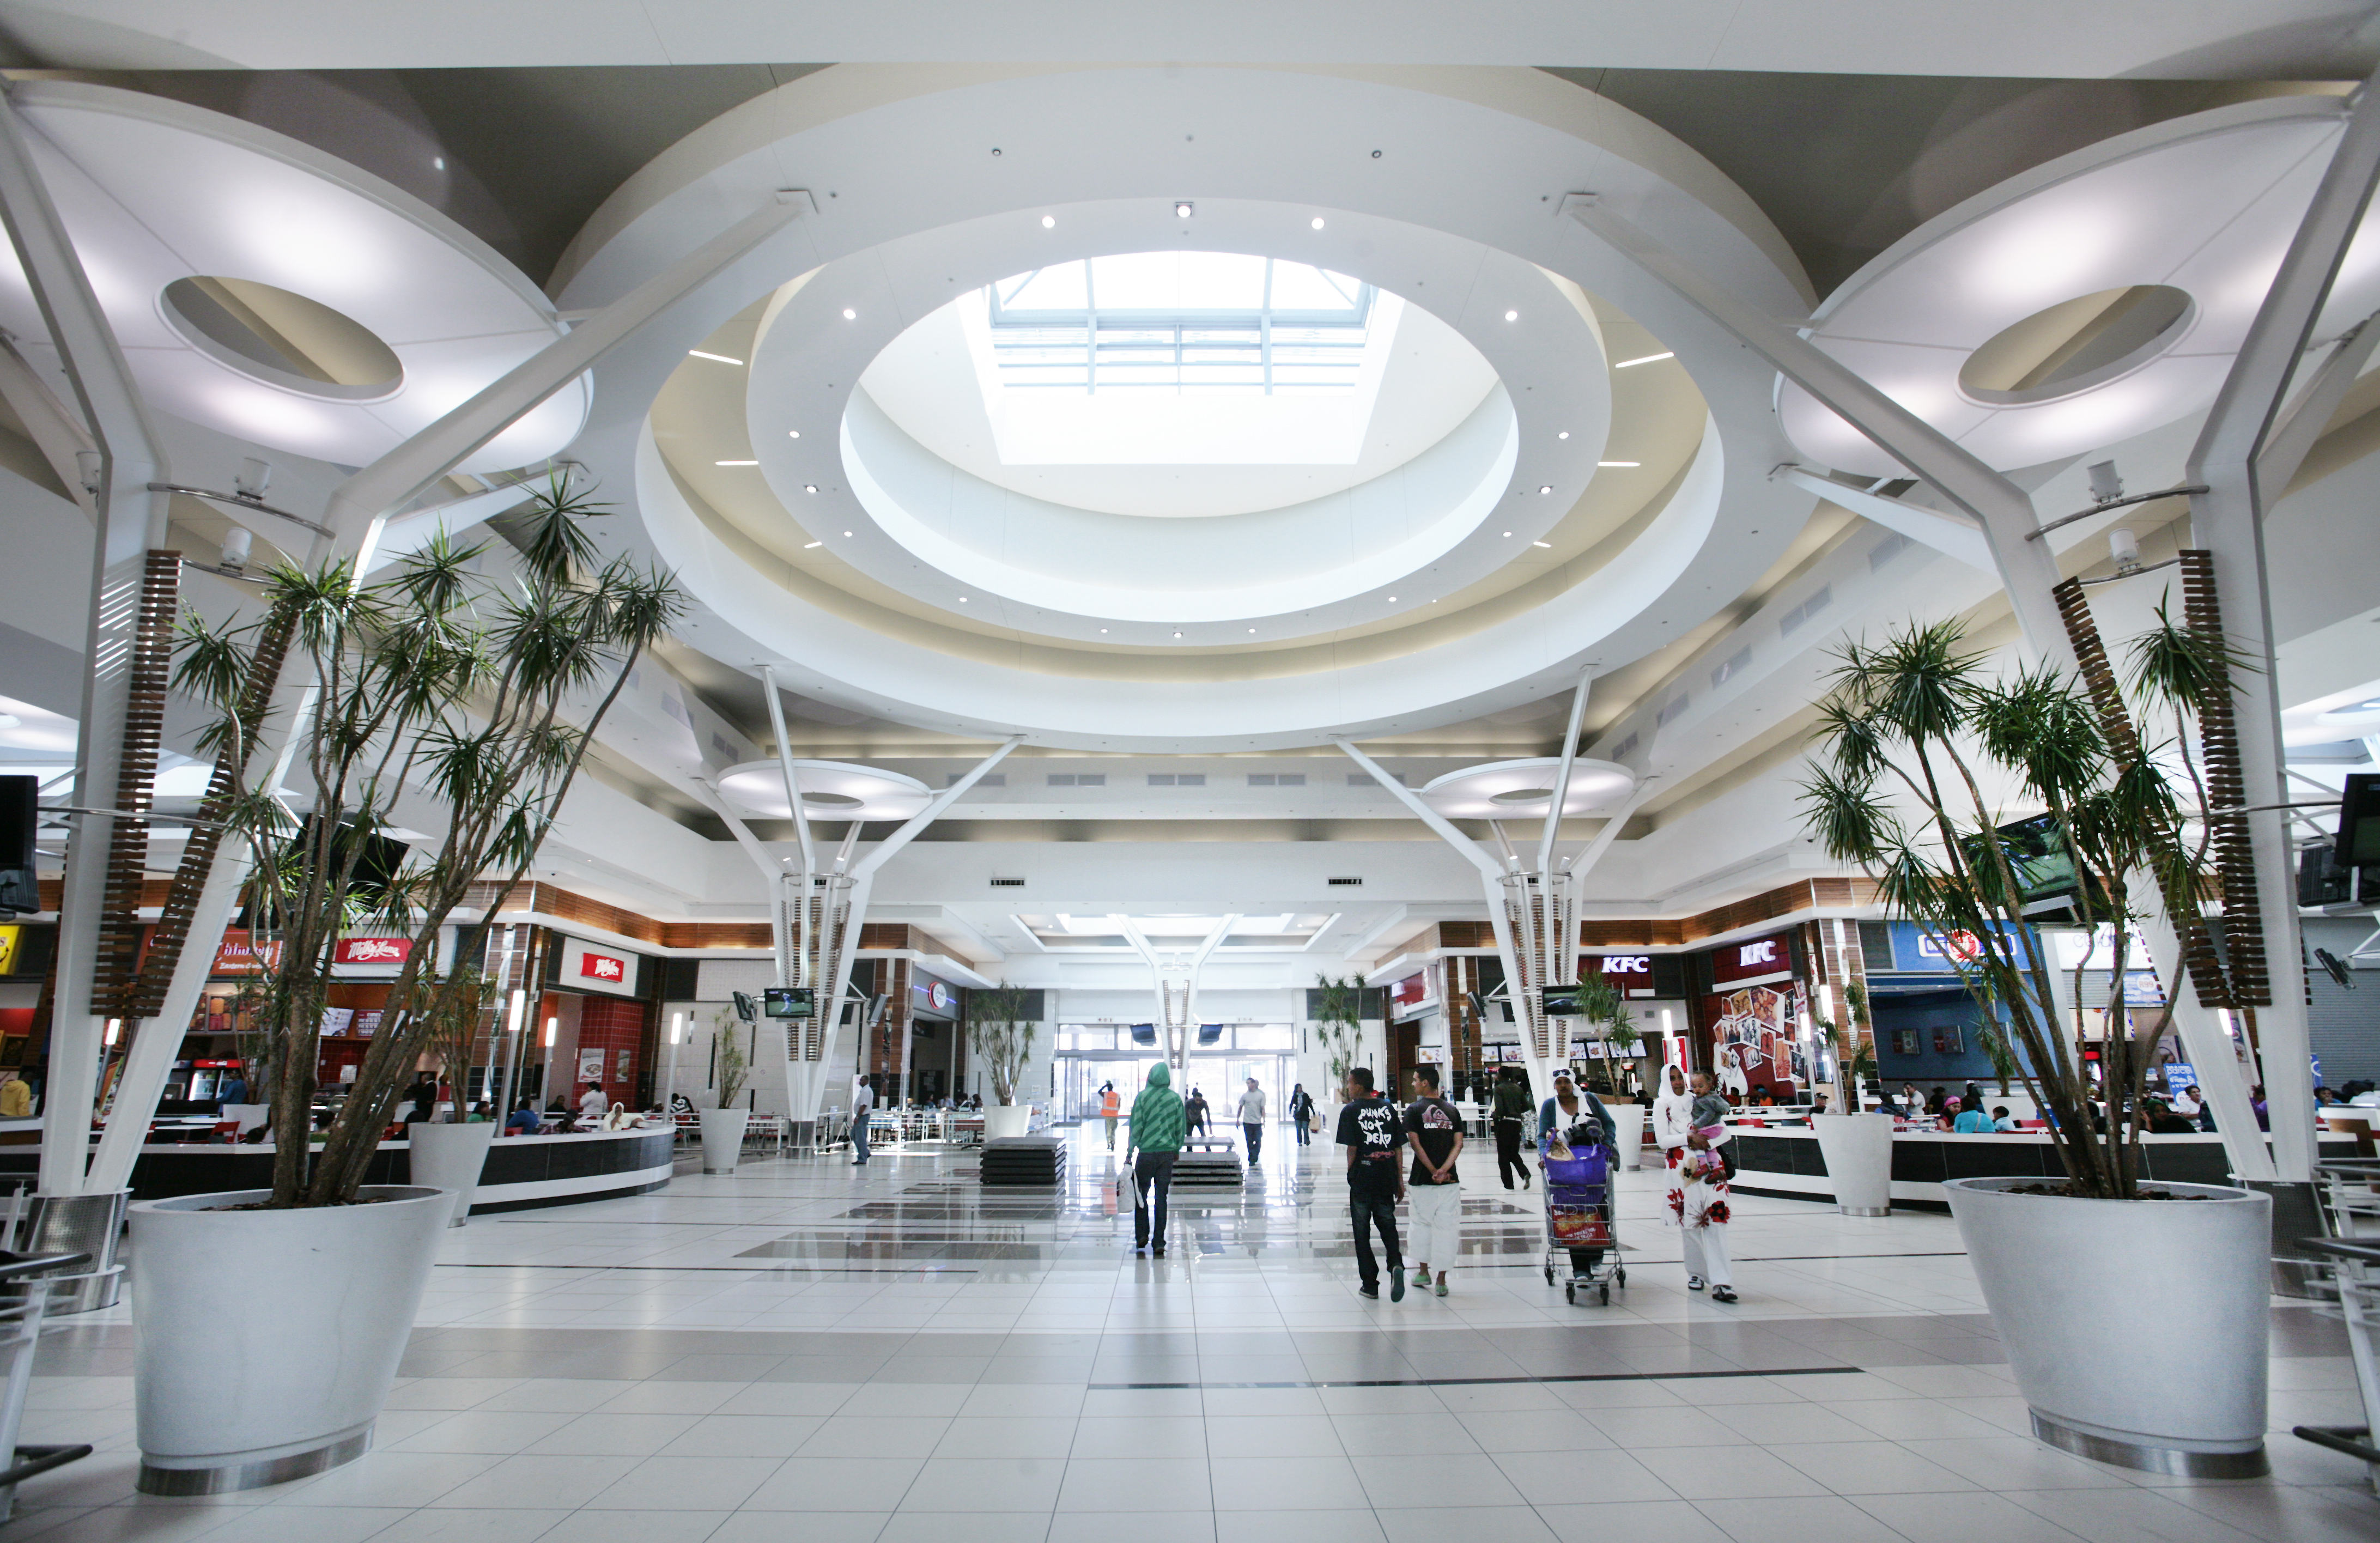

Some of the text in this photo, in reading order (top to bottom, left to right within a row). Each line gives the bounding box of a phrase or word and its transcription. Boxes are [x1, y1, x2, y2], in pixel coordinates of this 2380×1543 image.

[347, 940, 400, 960] Milky Lane
[1740, 940, 1776, 967] KFC
[1601, 957, 1650, 973] KFC
[1358, 1105, 1392, 1121] PUNKS
[1363, 1131, 1392, 1149] DEAD
